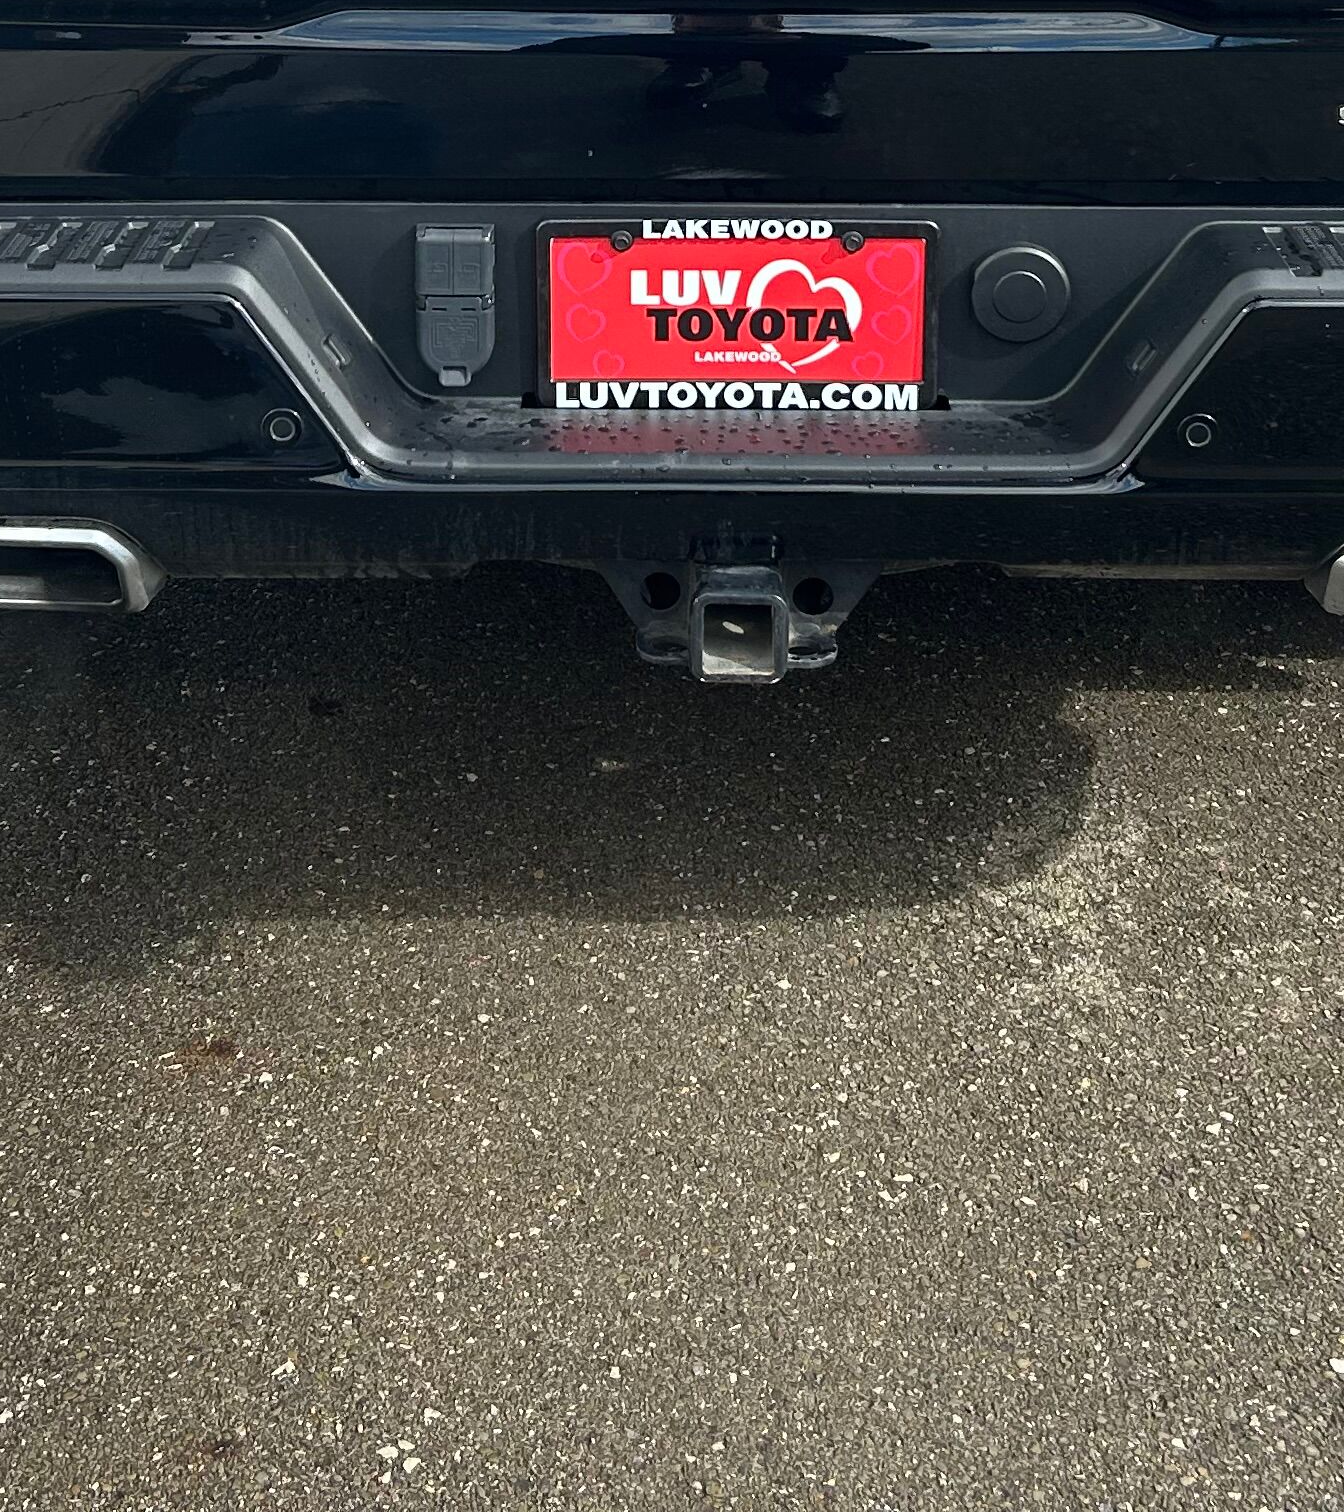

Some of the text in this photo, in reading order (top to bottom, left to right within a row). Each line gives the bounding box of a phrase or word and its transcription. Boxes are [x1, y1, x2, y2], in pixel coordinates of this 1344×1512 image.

[642, 219, 833, 240] LAKEWOOD
[629, 269, 742, 306] LUV
[646, 307, 854, 342] TOYOTA
[694, 351, 782, 363] LAKEWOOD
[555, 382, 919, 410] LUVTOYOTA.COM
